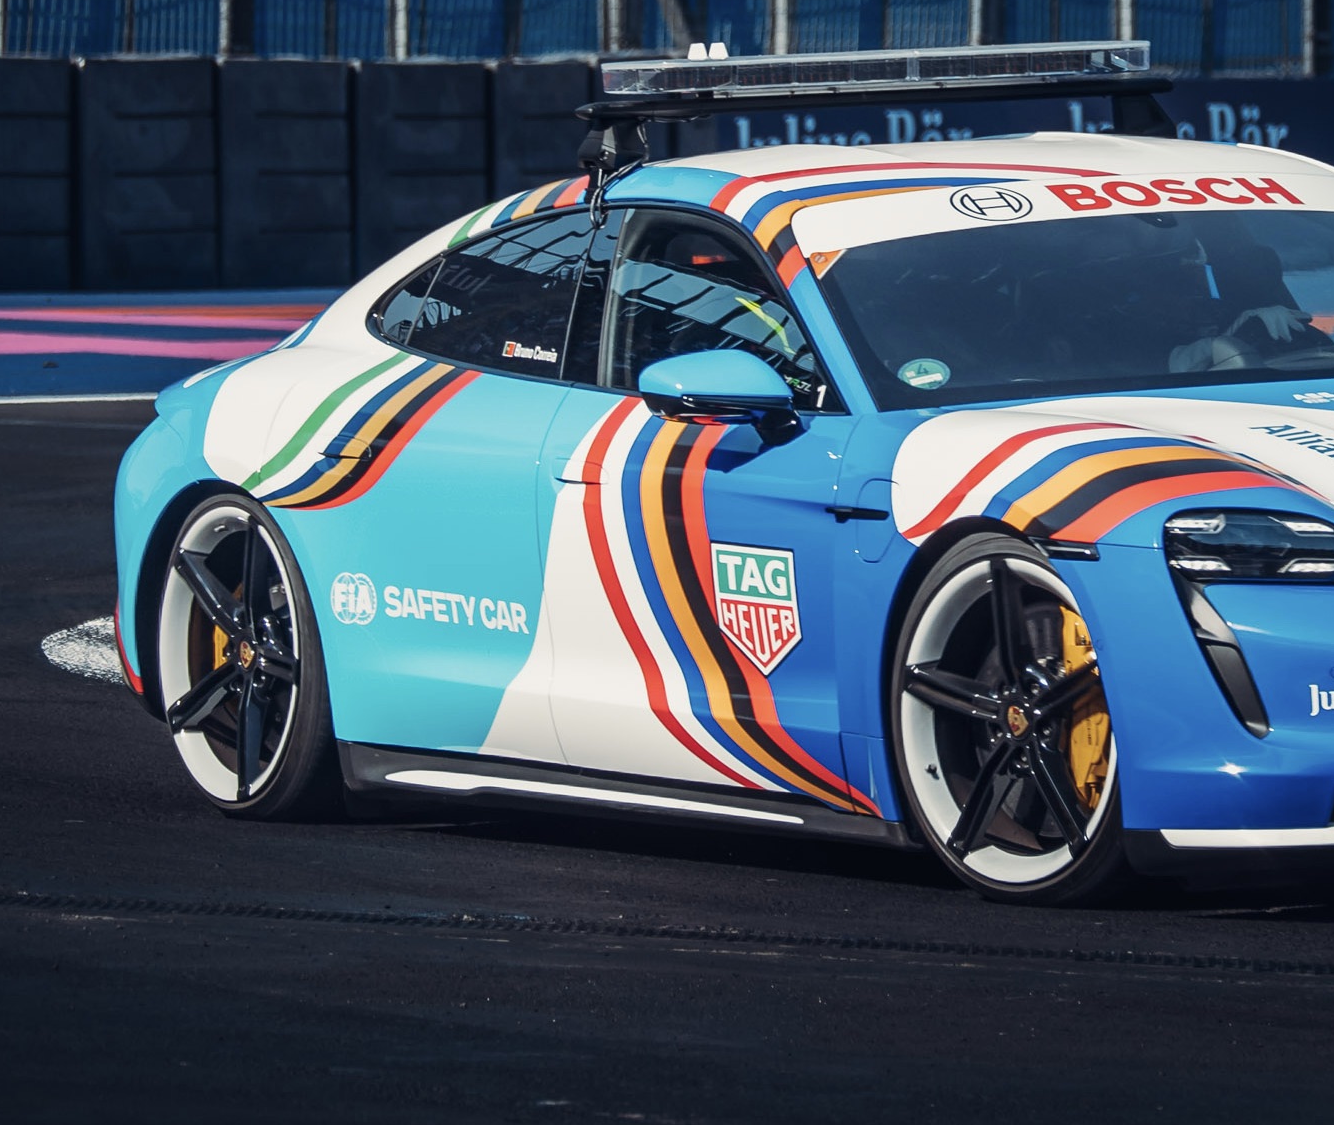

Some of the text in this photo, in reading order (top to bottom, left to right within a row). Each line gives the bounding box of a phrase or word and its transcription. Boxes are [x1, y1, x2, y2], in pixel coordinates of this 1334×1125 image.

[1044, 177, 1305, 211] BOSCH
[816, 384, 827, 408] 1
[718, 554, 788, 597] TAG
[383, 586, 476, 626] SAFETY
[479, 598, 530, 635] CAR
[722, 602, 795, 664] HEUER
